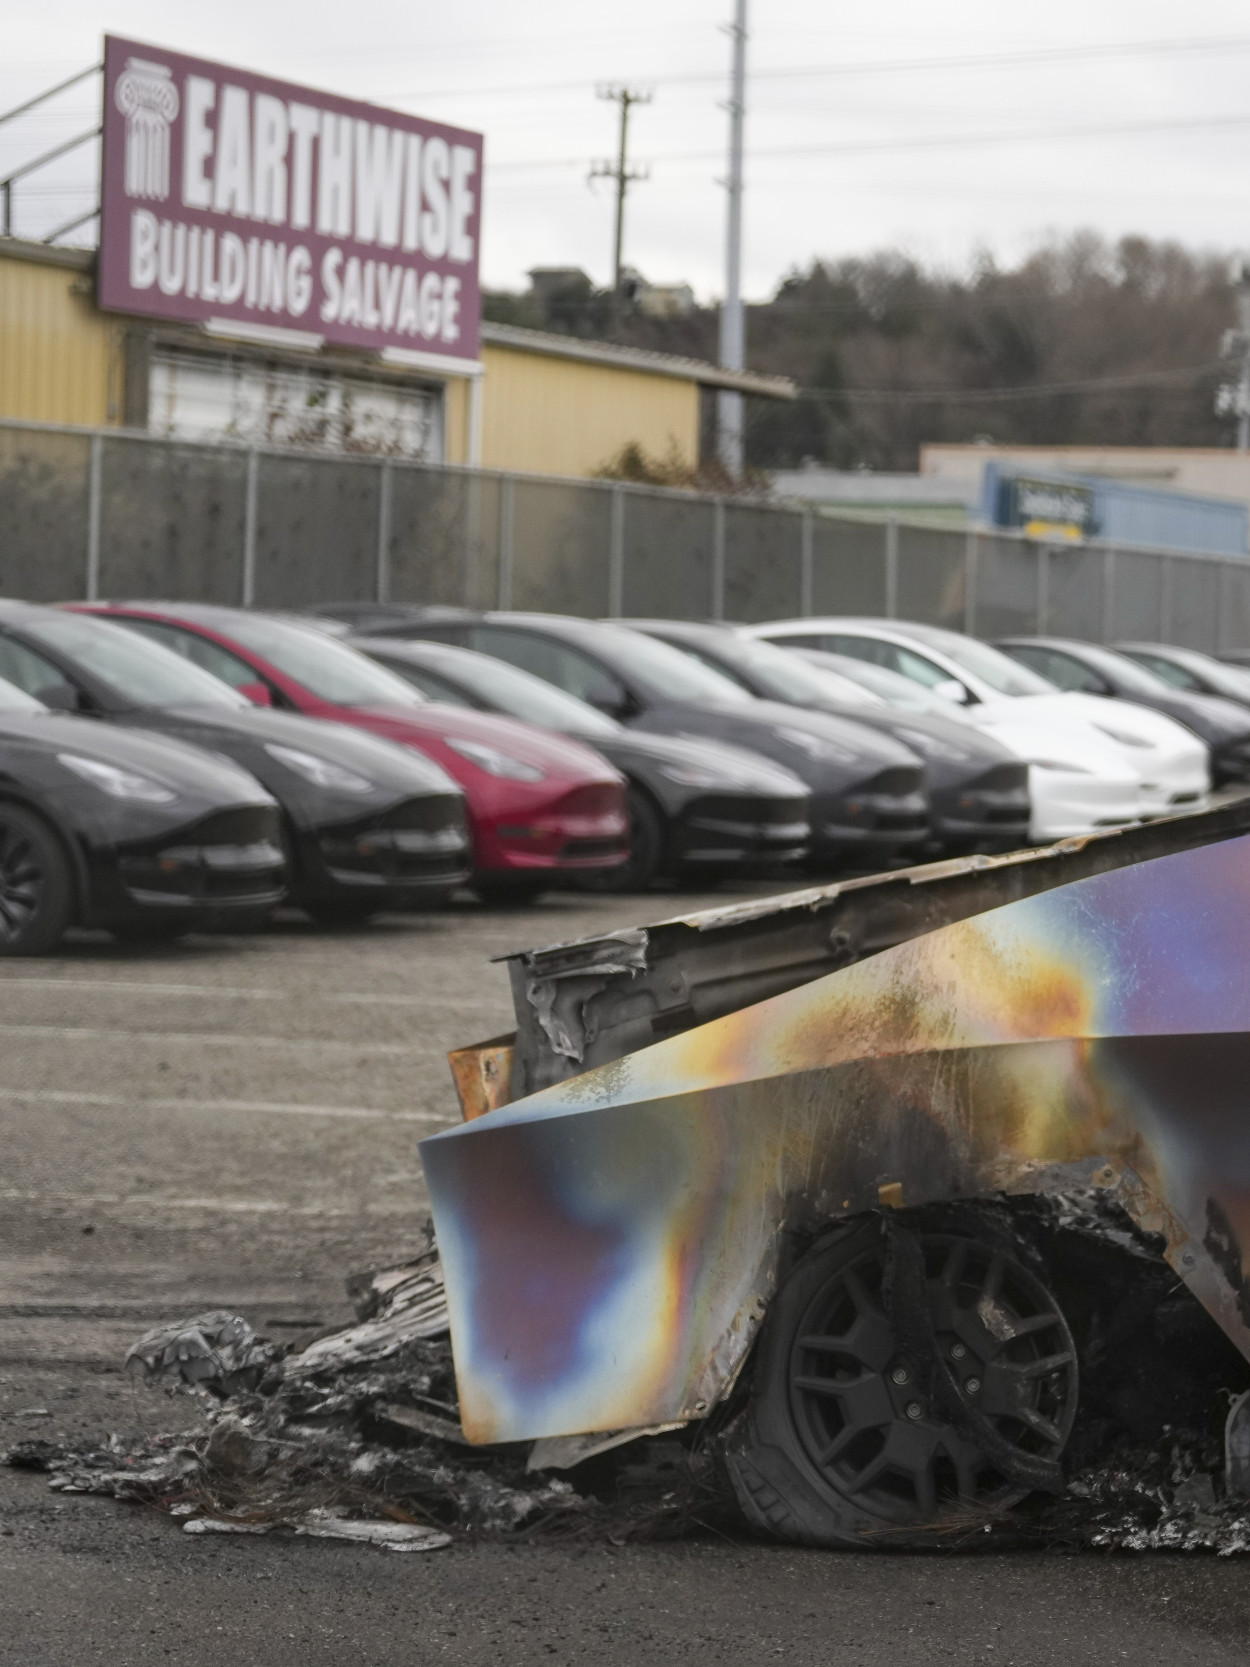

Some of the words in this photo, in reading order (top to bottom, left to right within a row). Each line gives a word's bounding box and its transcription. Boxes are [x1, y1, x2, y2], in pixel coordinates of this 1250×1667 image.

[181, 72, 476, 265] EARTHWISE
[129, 208, 313, 317] BUILDING
[320, 246, 461, 343] SALVAGE
